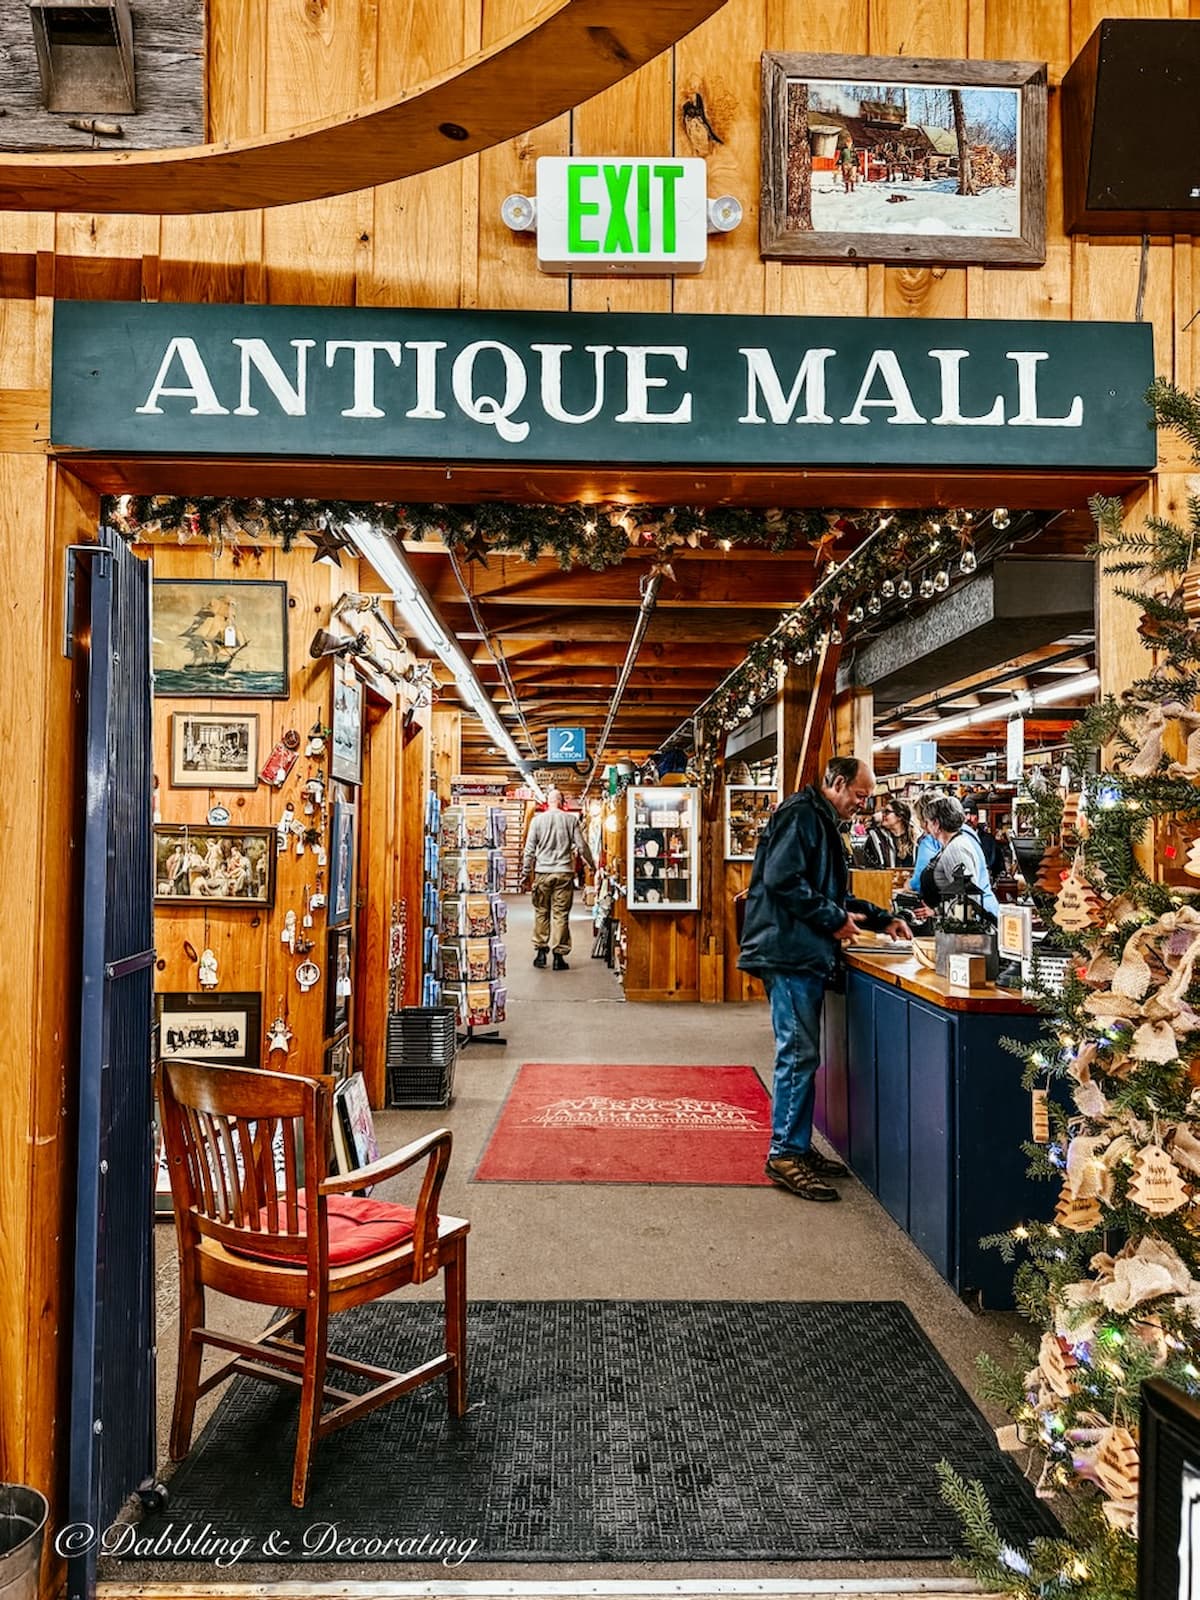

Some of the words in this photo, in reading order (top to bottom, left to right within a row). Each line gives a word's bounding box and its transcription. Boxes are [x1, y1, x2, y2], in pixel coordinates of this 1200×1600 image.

[567, 165, 684, 254] EXIT
[136, 338, 691, 443] ANTIQUE
[739, 349, 1083, 426] MALL
[559, 731, 575, 752] 2
[913, 744, 922, 763] 1
